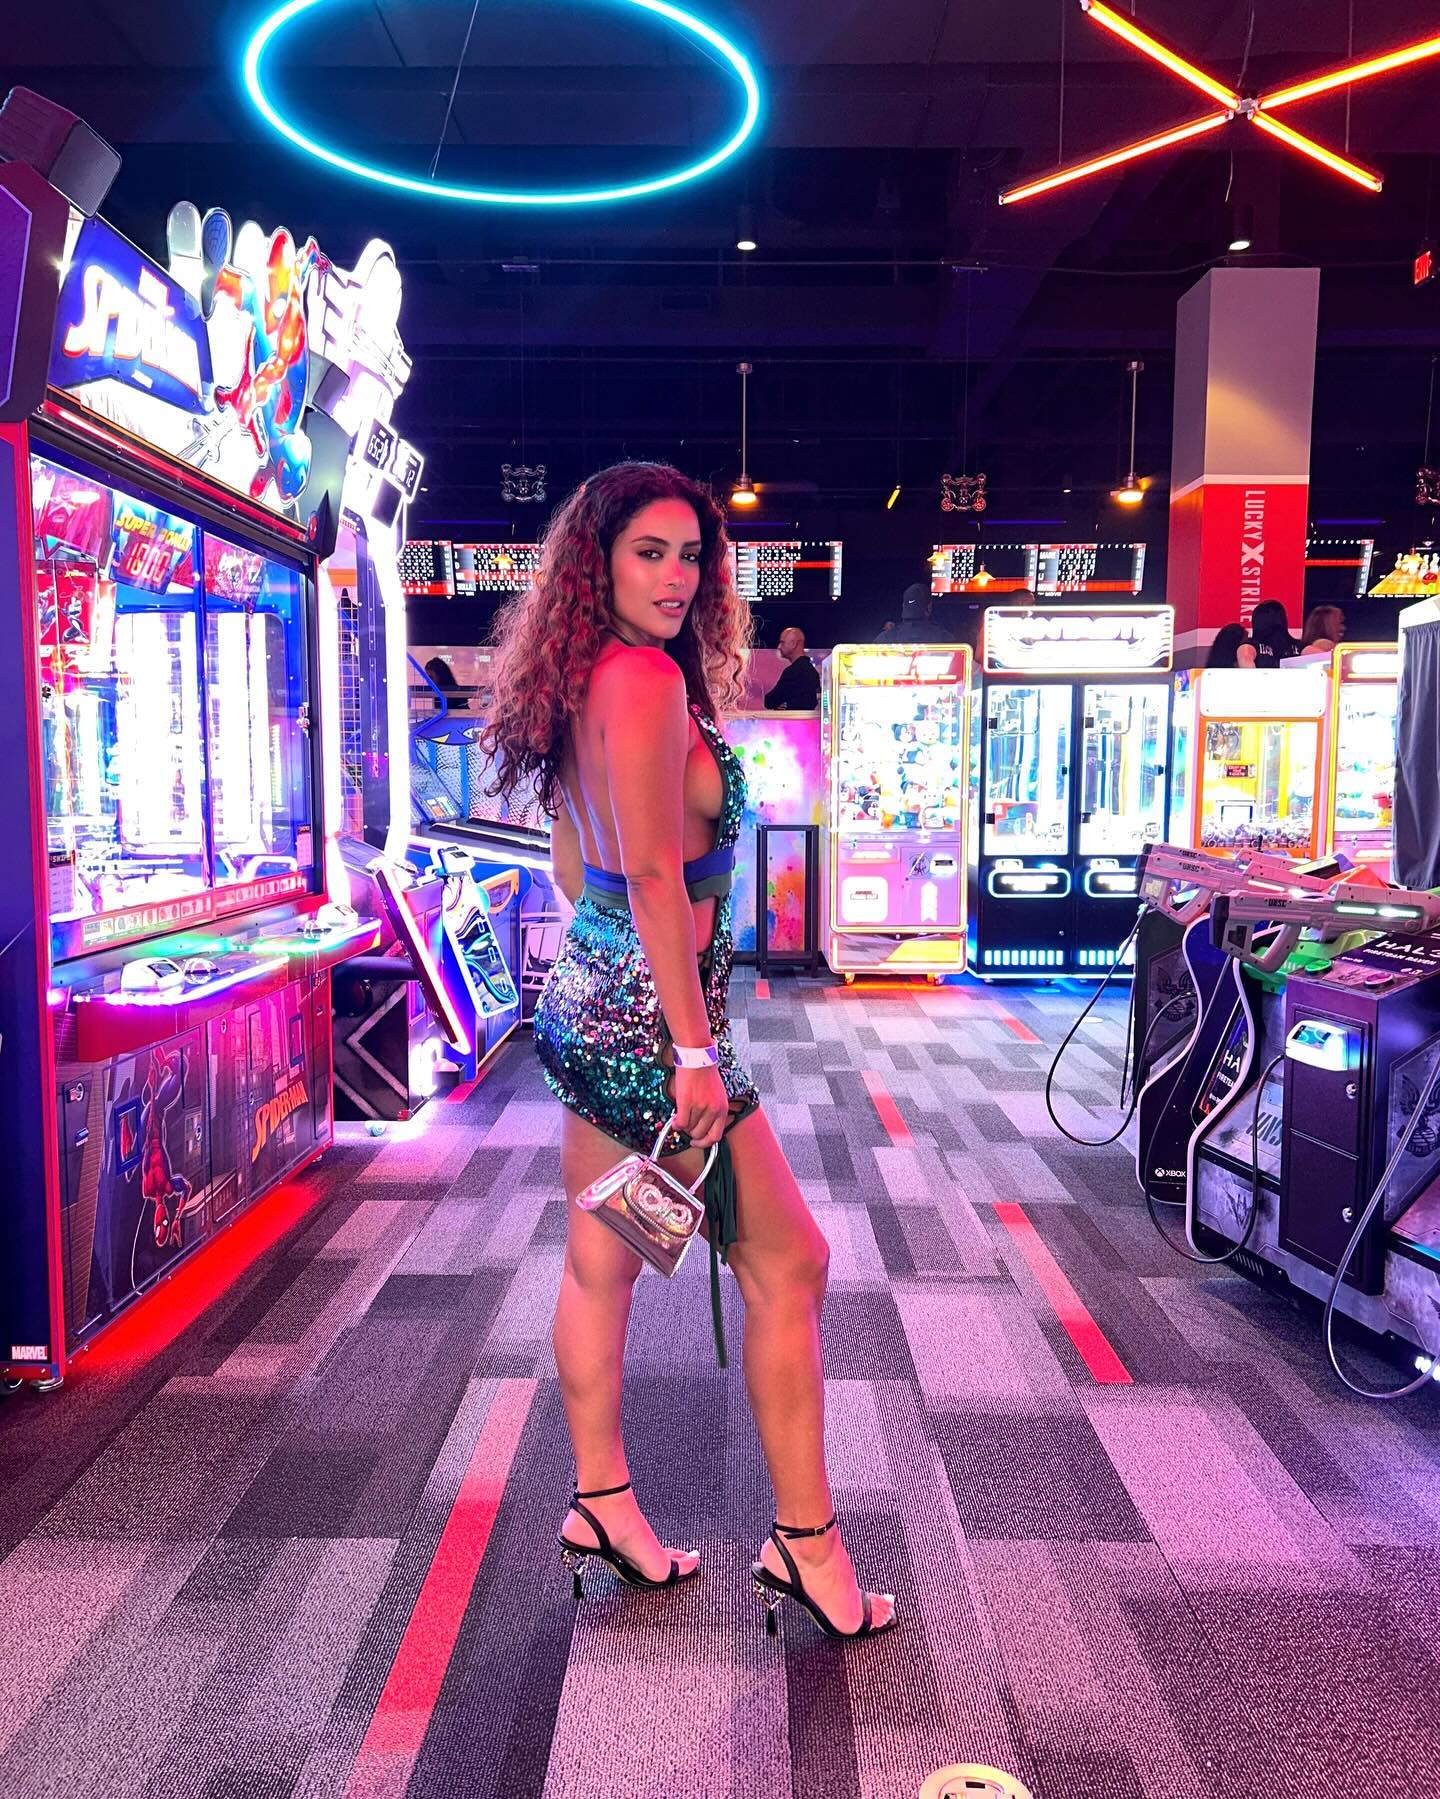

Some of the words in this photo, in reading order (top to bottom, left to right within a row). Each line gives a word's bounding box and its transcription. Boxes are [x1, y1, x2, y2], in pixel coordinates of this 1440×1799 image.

[1243, 489, 1266, 541] LUCKY
[1165, 1169, 1187, 1178] XBOX
[11, 1345, 48, 1360] MARVEL
